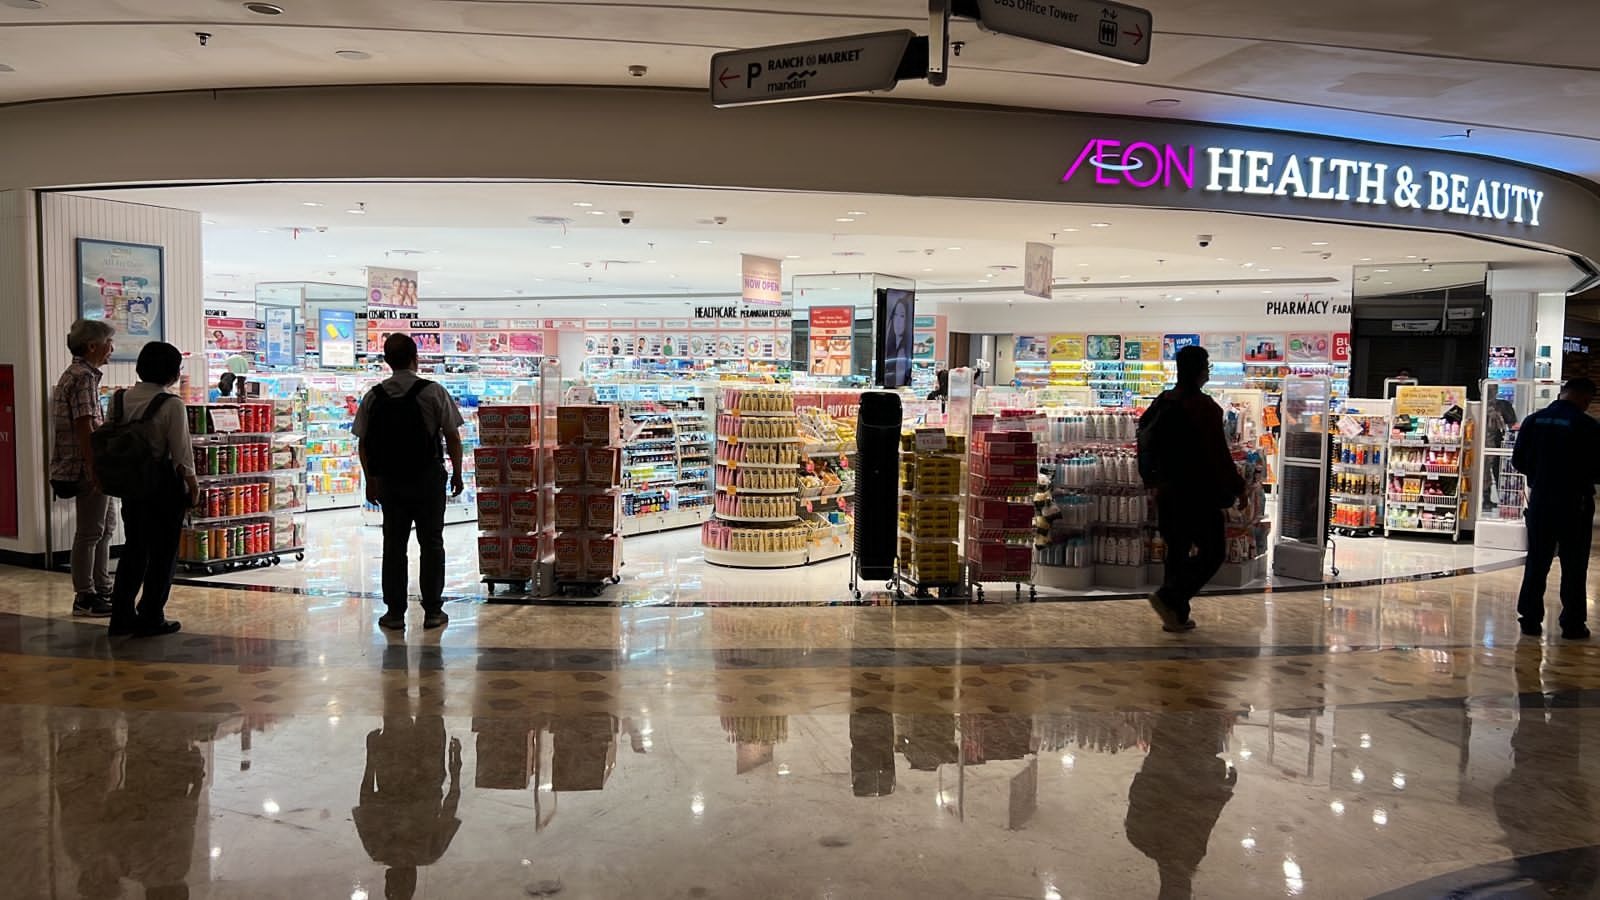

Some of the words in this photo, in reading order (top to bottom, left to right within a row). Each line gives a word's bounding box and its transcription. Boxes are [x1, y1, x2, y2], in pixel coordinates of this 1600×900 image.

[1017, 0, 1046, 15] Office
[1048, 5, 1079, 22] Tower
[768, 56, 804, 71] RANCH
[818, 49, 862, 65] MARKET
[747, 62, 762, 89] P
[1205, 147, 1388, 205] HEALTH
[1393, 165, 1423, 209] &
[1427, 170, 1545, 227] BEAUTY
[744, 279, 761, 289] NOW
[762, 281, 780, 292] OPEN
[694, 306, 737, 318] HEALTHCARE
[1266, 300, 1329, 315] PHARMACY
[827, 405, 843, 417] BUY
